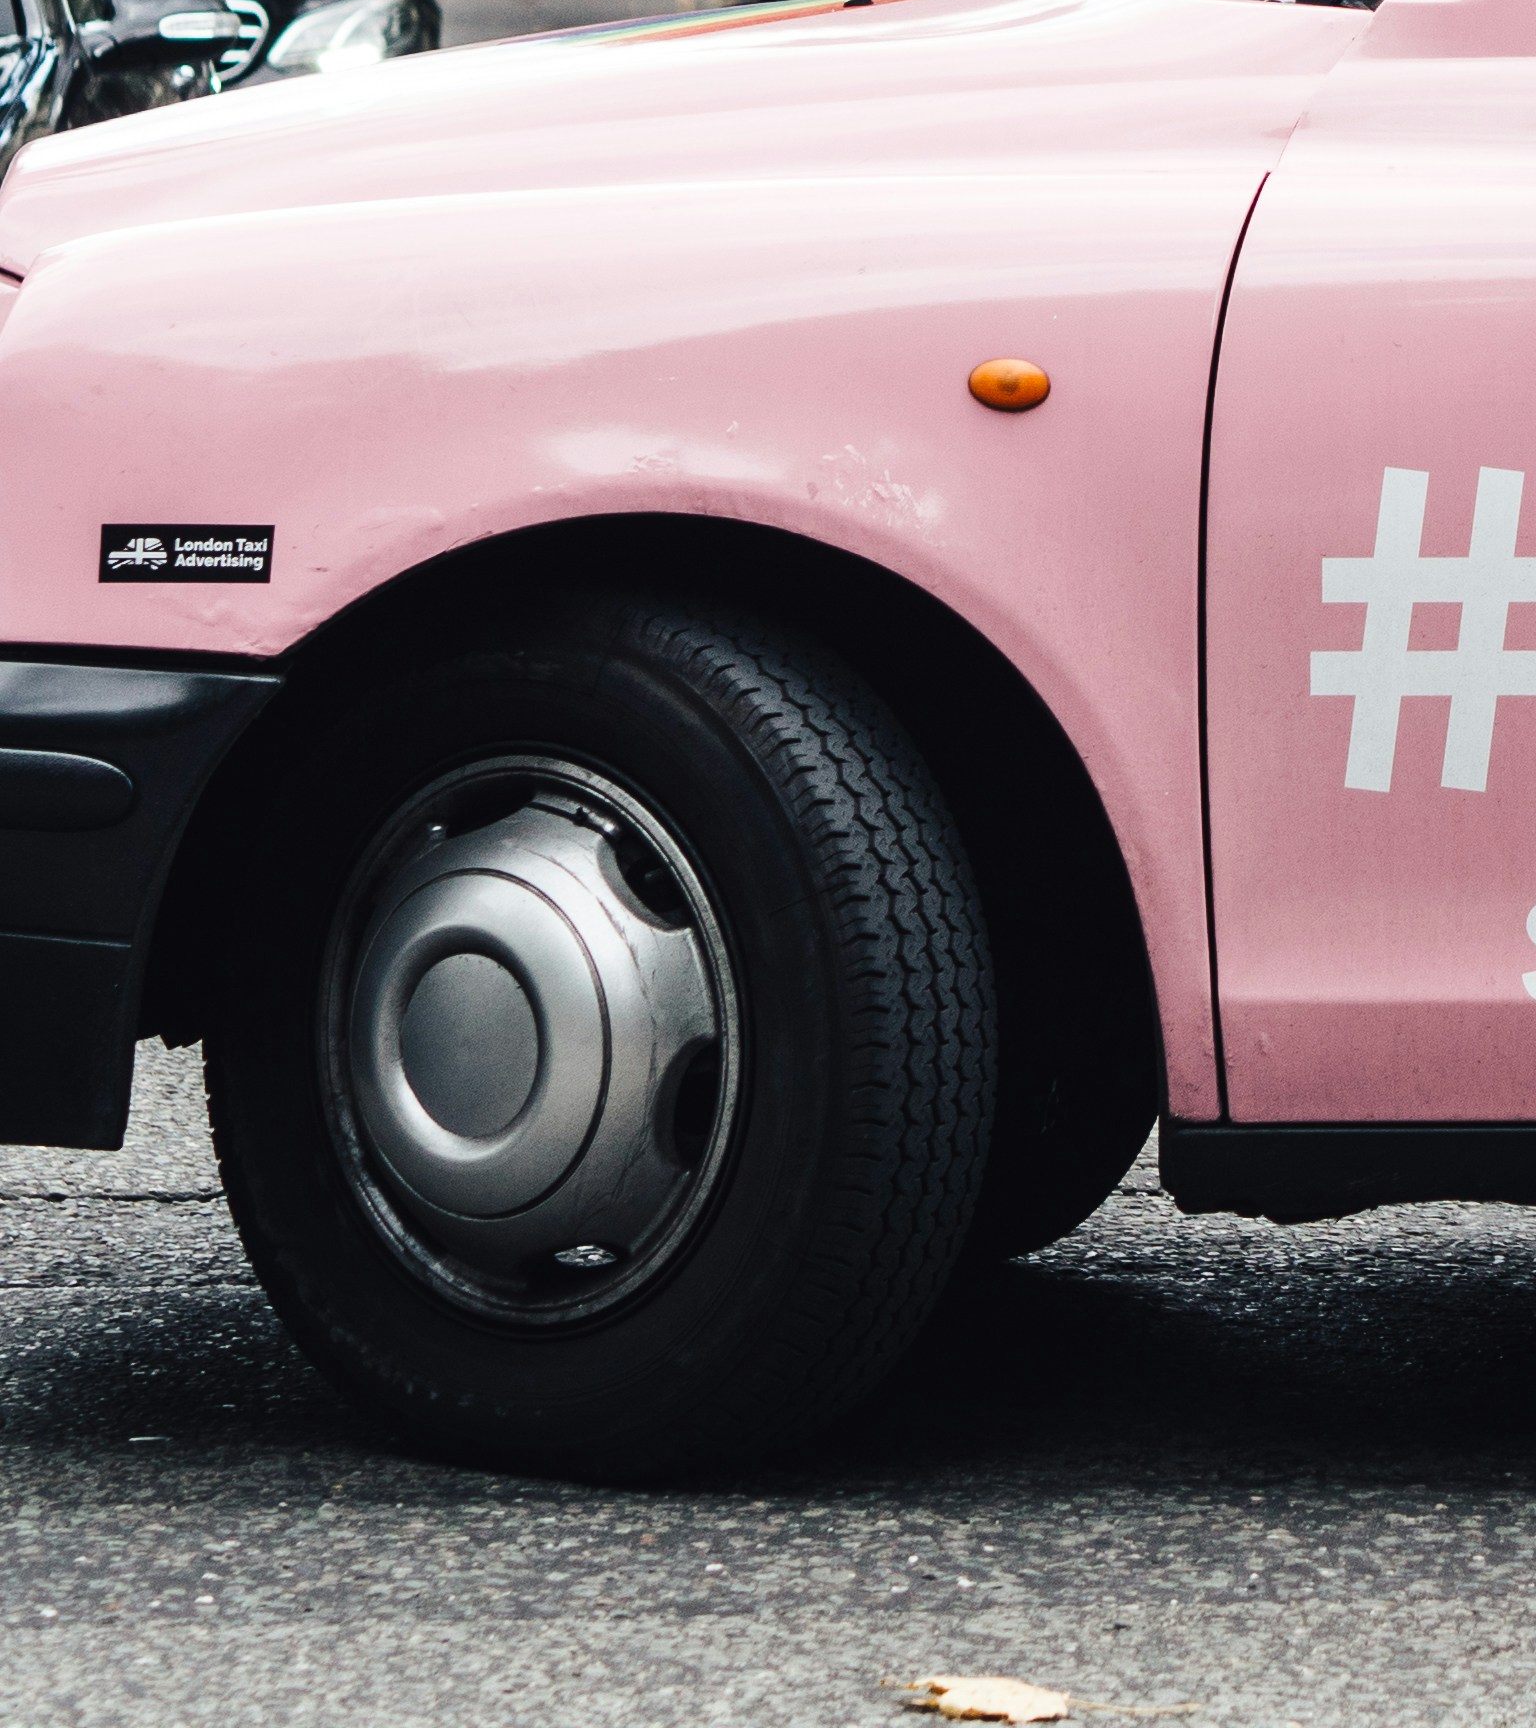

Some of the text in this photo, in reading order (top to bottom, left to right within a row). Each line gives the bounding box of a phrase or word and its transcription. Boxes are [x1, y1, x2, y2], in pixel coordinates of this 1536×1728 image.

[174, 537, 268, 552] London Taxi
[174, 553, 264, 571] Advertising
